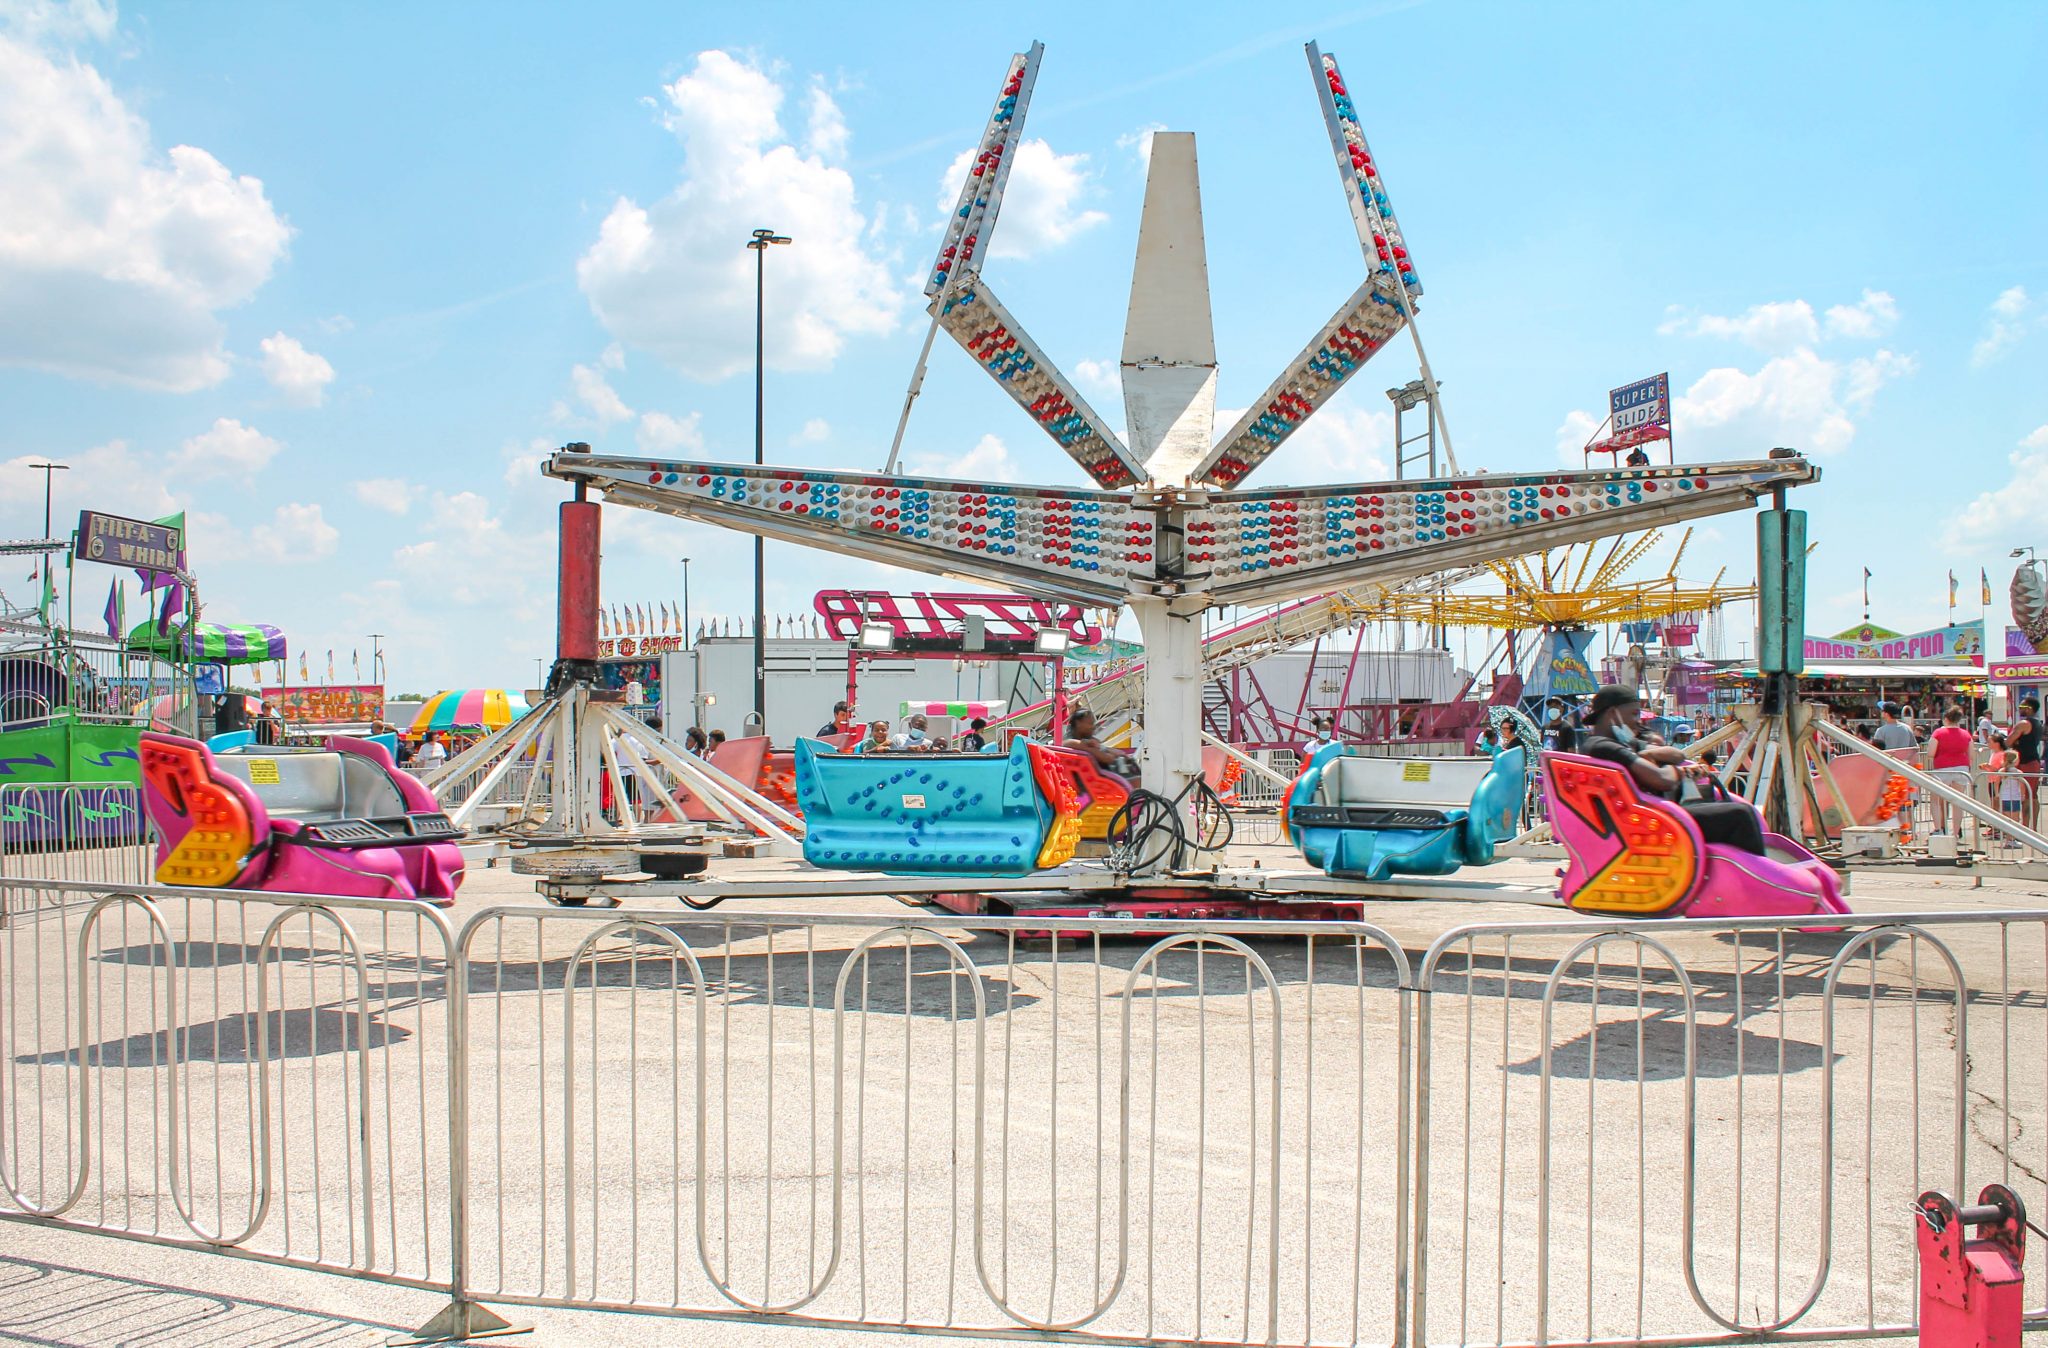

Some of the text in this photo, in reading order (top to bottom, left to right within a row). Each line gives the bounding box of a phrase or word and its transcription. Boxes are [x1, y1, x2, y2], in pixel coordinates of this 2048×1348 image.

[1614, 385, 1655, 410] SUPER
[1616, 405, 1655, 428] SLIDE
[119, 543, 176, 568] WHIRL
[619, 640, 636, 654] THE
[641, 636, 682, 656] SHOT
[1804, 639, 1856, 659] AMES
[1909, 633, 1944, 659] FUN
[1994, 666, 2048, 678] CONES
[308, 691, 346, 705] GUN
[283, 703, 379, 720] SLINGERS
